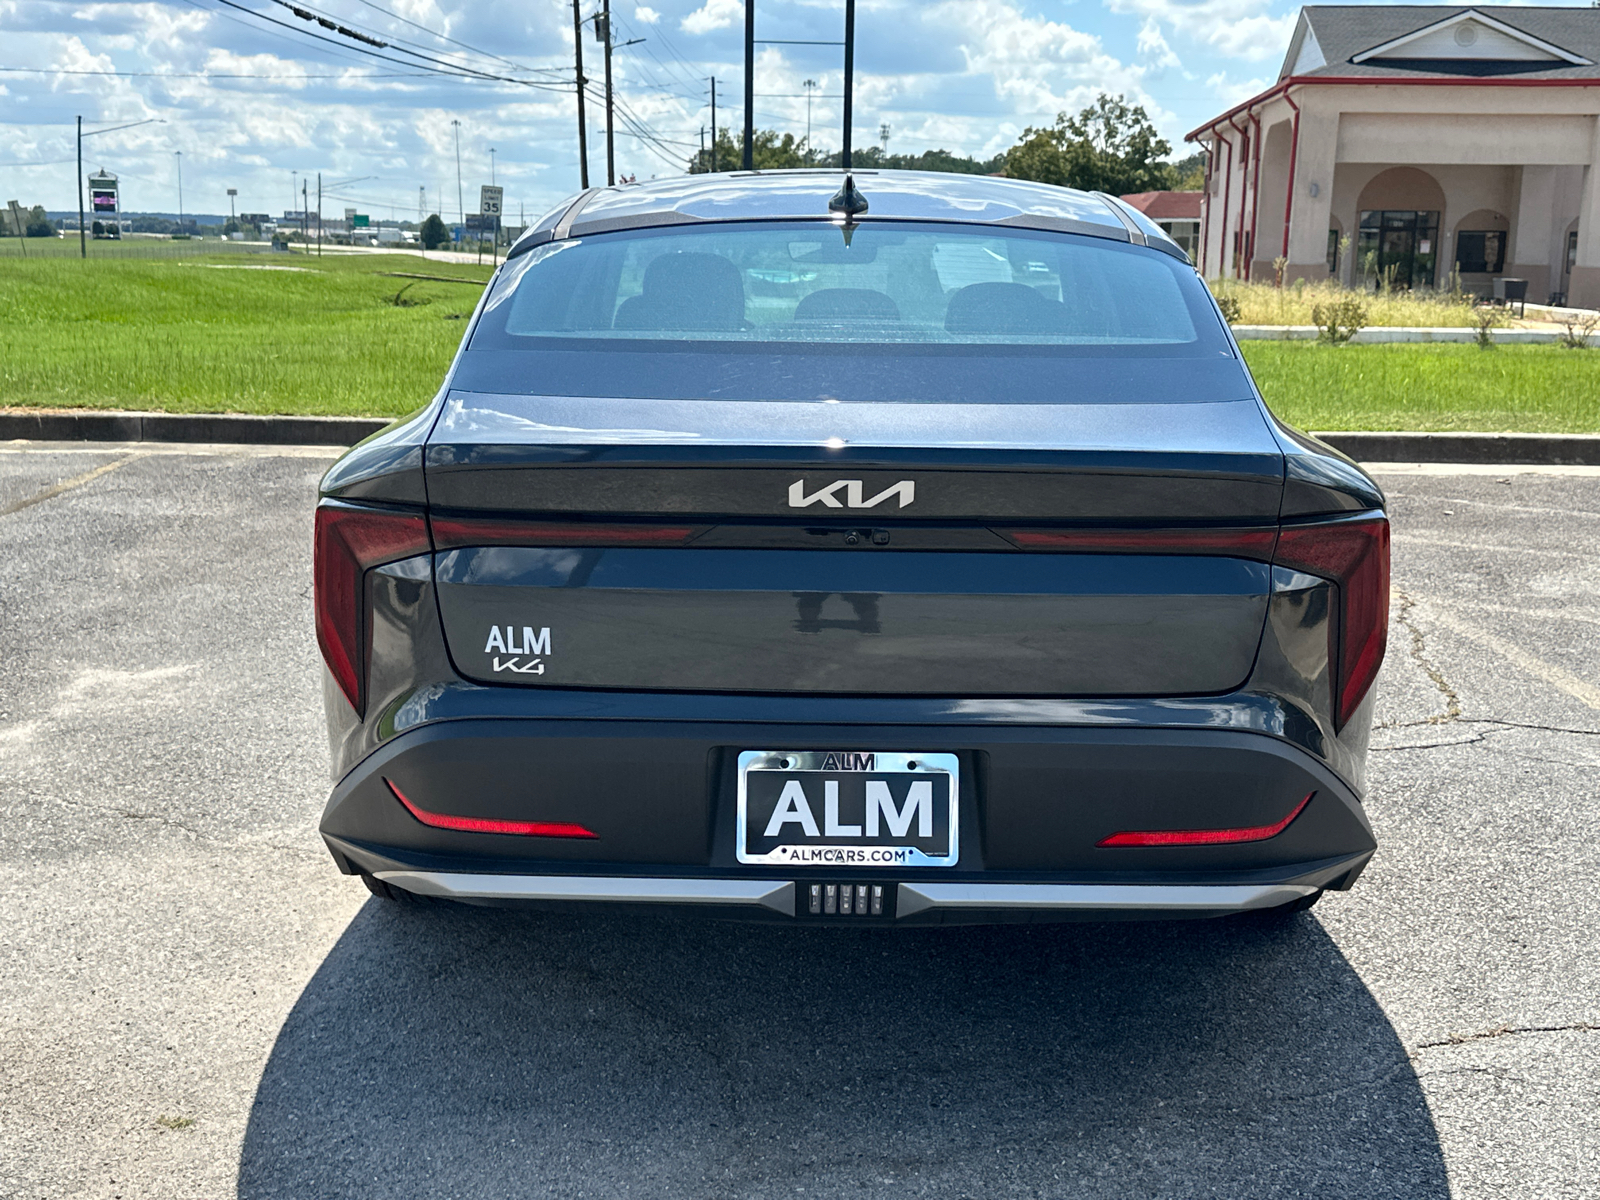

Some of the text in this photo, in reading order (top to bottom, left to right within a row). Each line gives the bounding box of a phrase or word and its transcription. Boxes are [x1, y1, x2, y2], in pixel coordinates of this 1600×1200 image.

[483, 202, 499, 213] 35
[788, 479, 915, 509] KIA
[484, 625, 552, 656] ALM
[492, 656, 545, 676] K4
[821, 752, 876, 771] ALM
[763, 780, 933, 838] ALM
[789, 848, 907, 864] ALMCARS.COM
